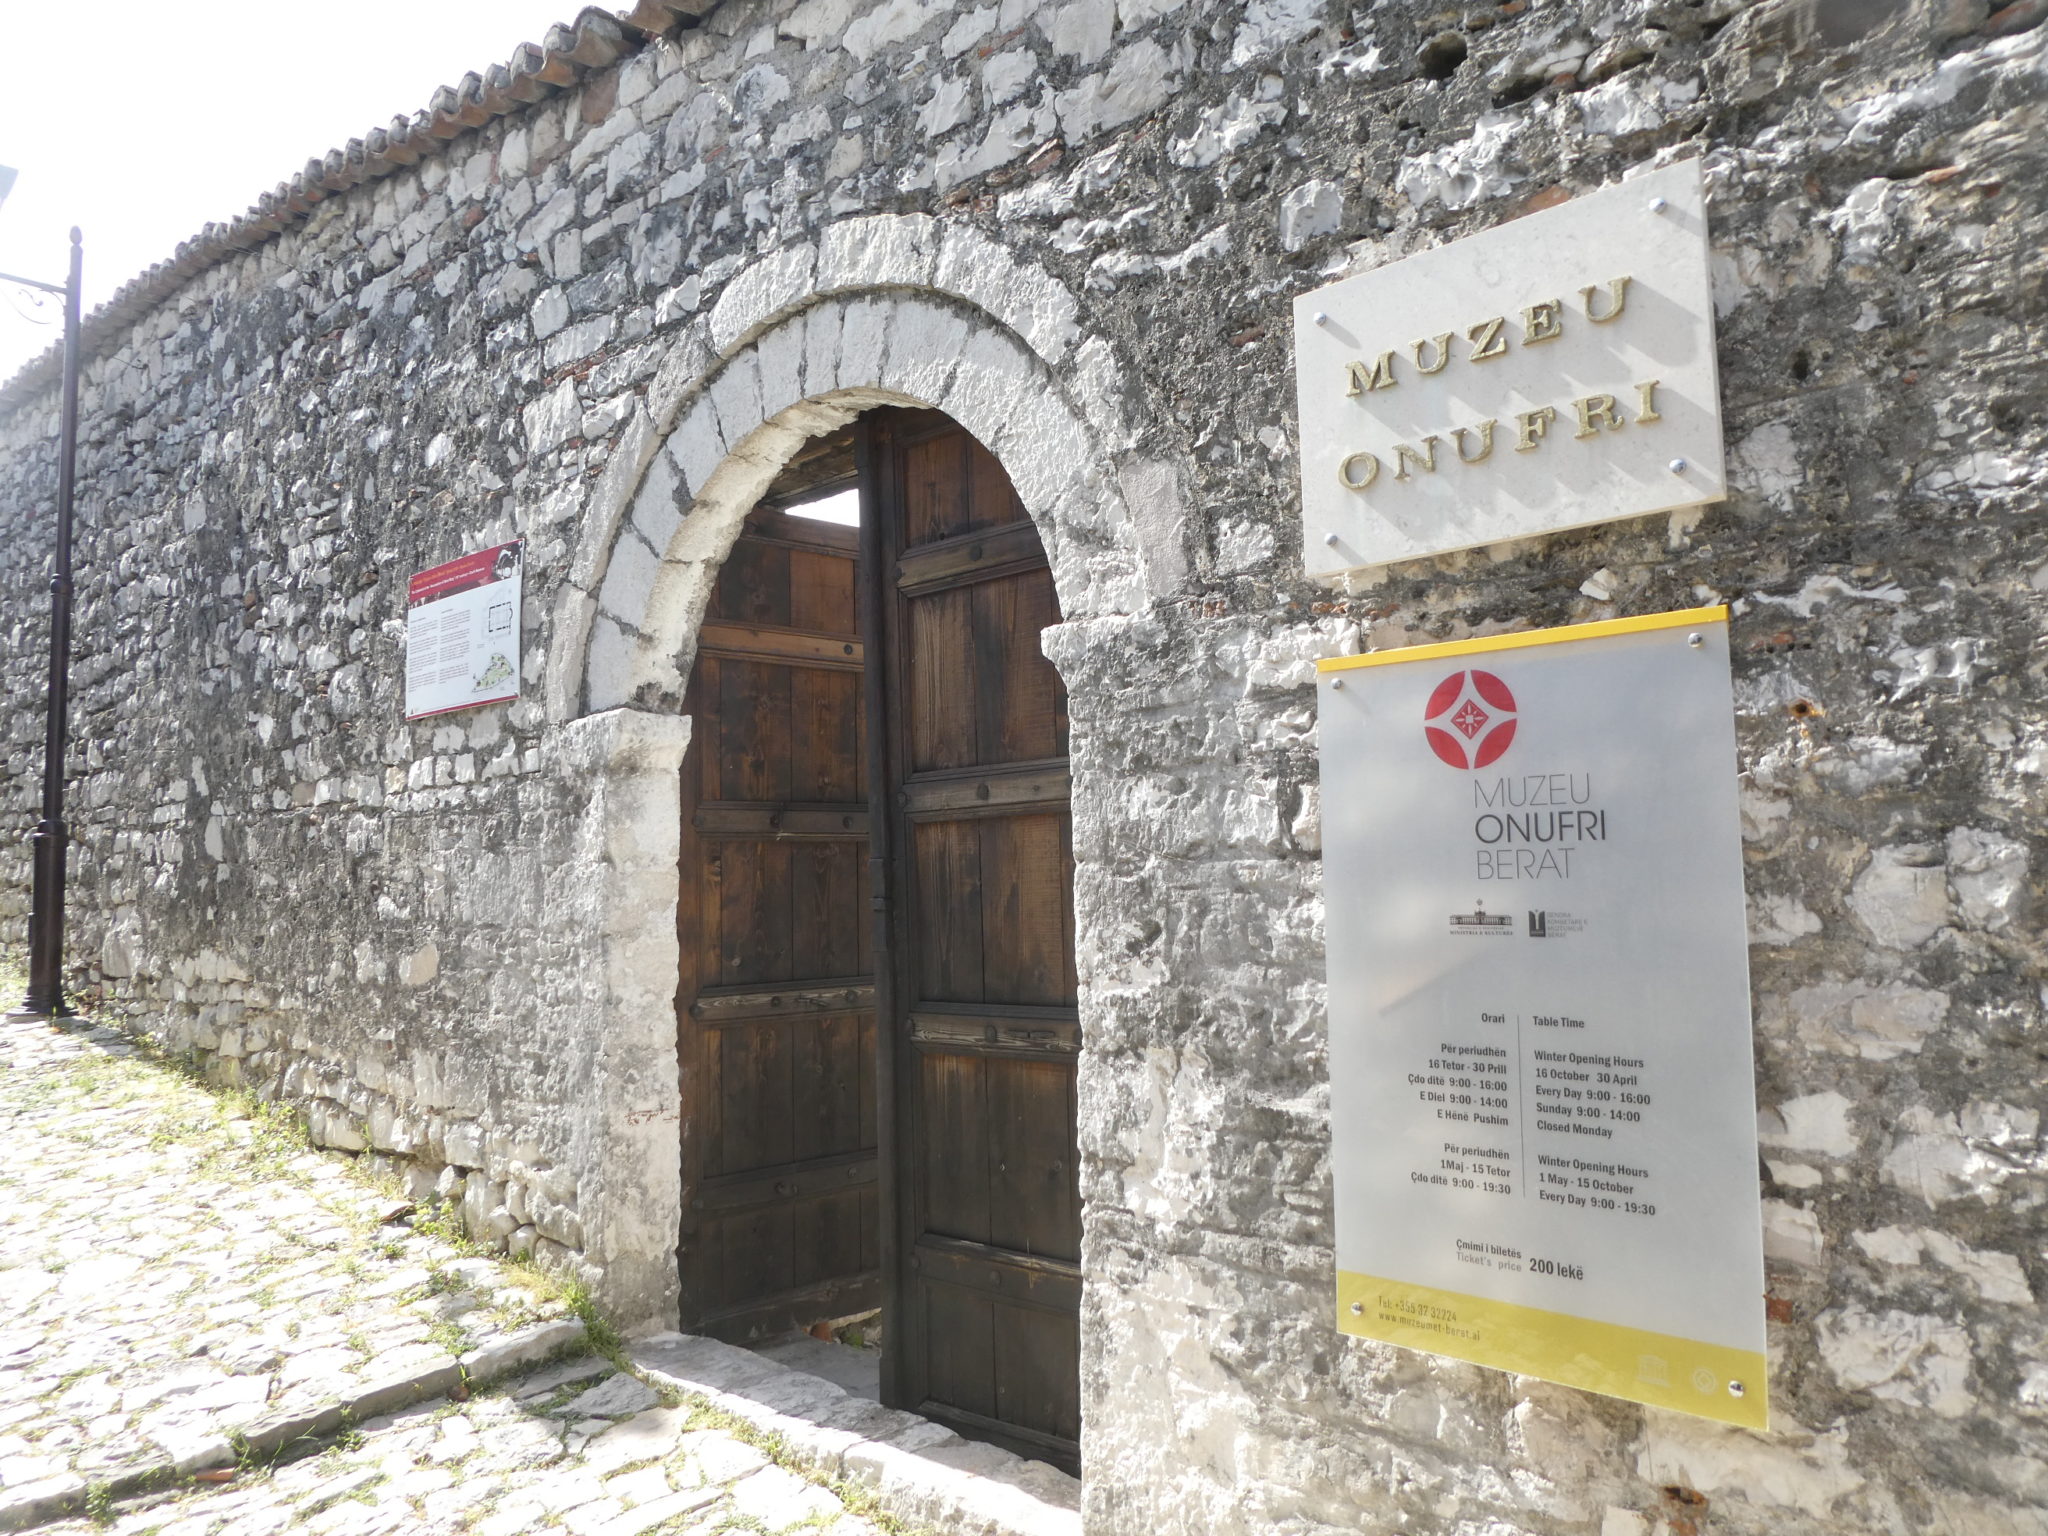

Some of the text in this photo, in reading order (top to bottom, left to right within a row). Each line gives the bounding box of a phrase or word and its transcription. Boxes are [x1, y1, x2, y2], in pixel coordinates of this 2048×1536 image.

[1345, 275, 1632, 398] MUZEU
[1337, 379, 1661, 490] ONUFRI
[1474, 772, 1590, 808] MUZEU
[1475, 809, 1606, 844] ONUFRI
[1477, 847, 1575, 880] BERAT
[1481, 1012, 1505, 1024] Orari
[1533, 1015, 1585, 1028] Table Time
[1441, 1043, 1506, 1058] Për periudhën
[1534, 1049, 1644, 1068] Winter Opening Hours
[1429, 1059, 1440, 1069] 16
[1441, 1059, 1465, 1071] Tetor
[1472, 1062, 1485, 1073] 30
[1487, 1063, 1507, 1075] Prill
[1536, 1067, 1637, 1087] 16 October 30 April
[1408, 1073, 1425, 1086] Çdo
[1427, 1075, 1445, 1086] ditë
[1449, 1077, 1471, 1088] 9:00
[1480, 1079, 1508, 1092] 16:00
[1420, 1090, 1425, 1100] E
[1428, 1091, 1445, 1103] Diel
[1449, 1093, 1471, 1105] 9:00
[1480, 1096, 1508, 1109] 14:00
[1536, 1085, 1561, 1100] Every
[1563, 1087, 1582, 1100] Day
[1586, 1089, 1611, 1101] 9:00
[1619, 1092, 1651, 1105] 16:00
[1437, 1108, 1509, 1126] E Hënë Pushim
[1536, 1102, 1572, 1117] Sunday
[1576, 1106, 1600, 1118] 9:00
[1610, 1109, 1640, 1122] 14:00
[1537, 1119, 1613, 1139] Closed Monday
[1444, 1142, 1510, 1160] Për periudhën
[1472, 1163, 1484, 1174] 15
[1486, 1165, 1511, 1178] Tetor
[1538, 1154, 1649, 1178] Winter Opening Hours
[1411, 1171, 1428, 1184] Çdo
[1430, 1173, 1448, 1186] ditë
[1452, 1177, 1474, 1189] 9:00
[1483, 1181, 1511, 1195] 19:30
[1539, 1172, 1544, 1182] 1
[1547, 1173, 1568, 1187] May
[1577, 1178, 1590, 1188] 15
[1592, 1179, 1634, 1194] October
[1539, 1189, 1565, 1205] Every
[1567, 1193, 1586, 1207] Day
[1590, 1197, 1615, 1210] 9:00
[1624, 1201, 1656, 1216] 19:30
[1456, 1238, 1522, 1259] Çmimi i biletës
[1498, 1260, 1522, 1272] price
[1529, 1257, 1584, 1280] 200 lekë
